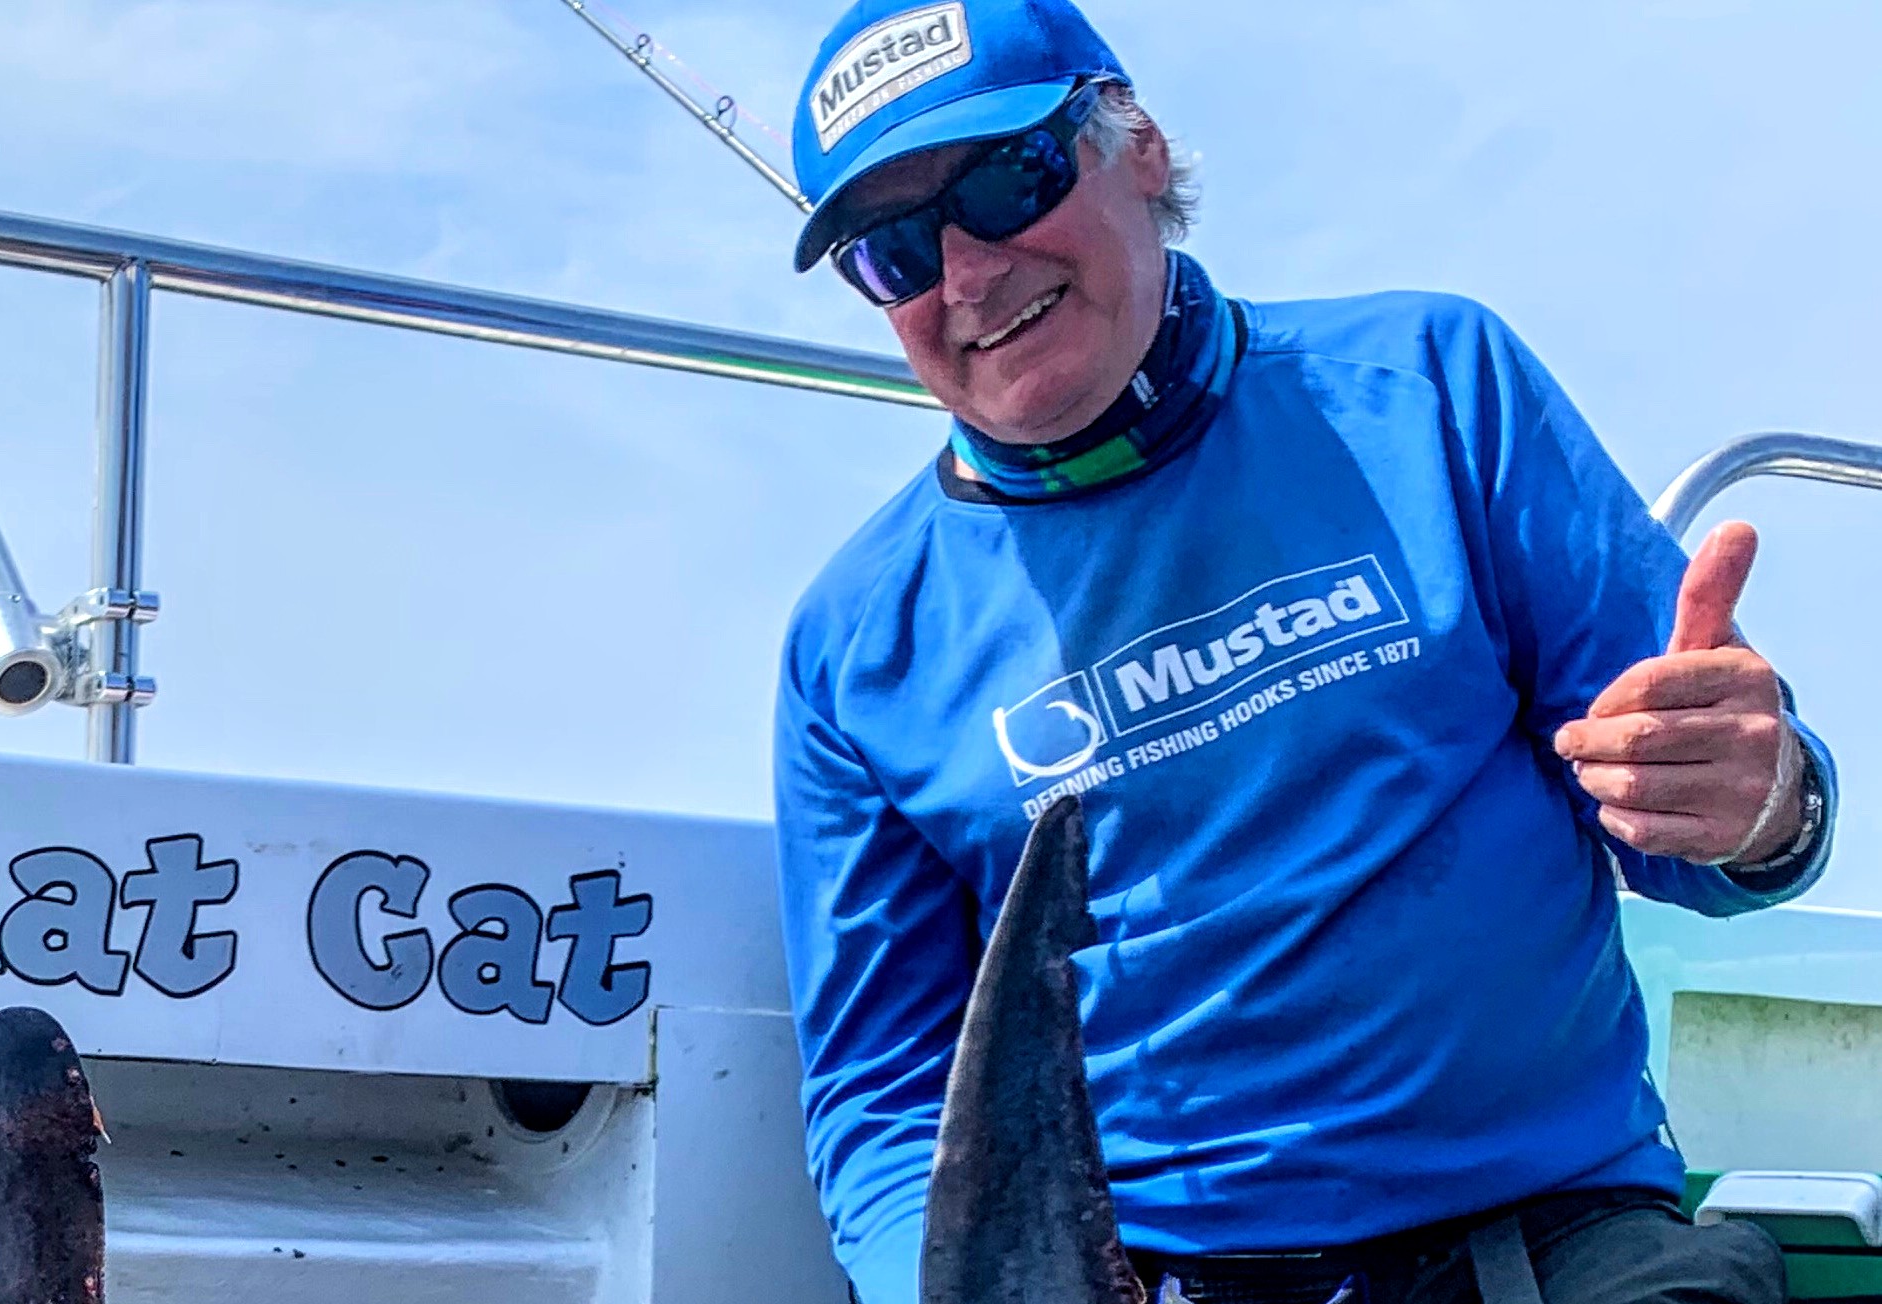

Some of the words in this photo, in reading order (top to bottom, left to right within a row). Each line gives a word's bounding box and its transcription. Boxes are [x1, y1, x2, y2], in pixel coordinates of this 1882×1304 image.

[817, 13, 953, 121] Mustad
[1113, 574, 1382, 712] Mustad
[1126, 720, 1219, 770] FISHING
[1218, 678, 1297, 732] HOOKS
[1297, 651, 1372, 692] SINCE
[1373, 637, 1421, 666] 1877
[308, 849, 656, 1027] Cat
